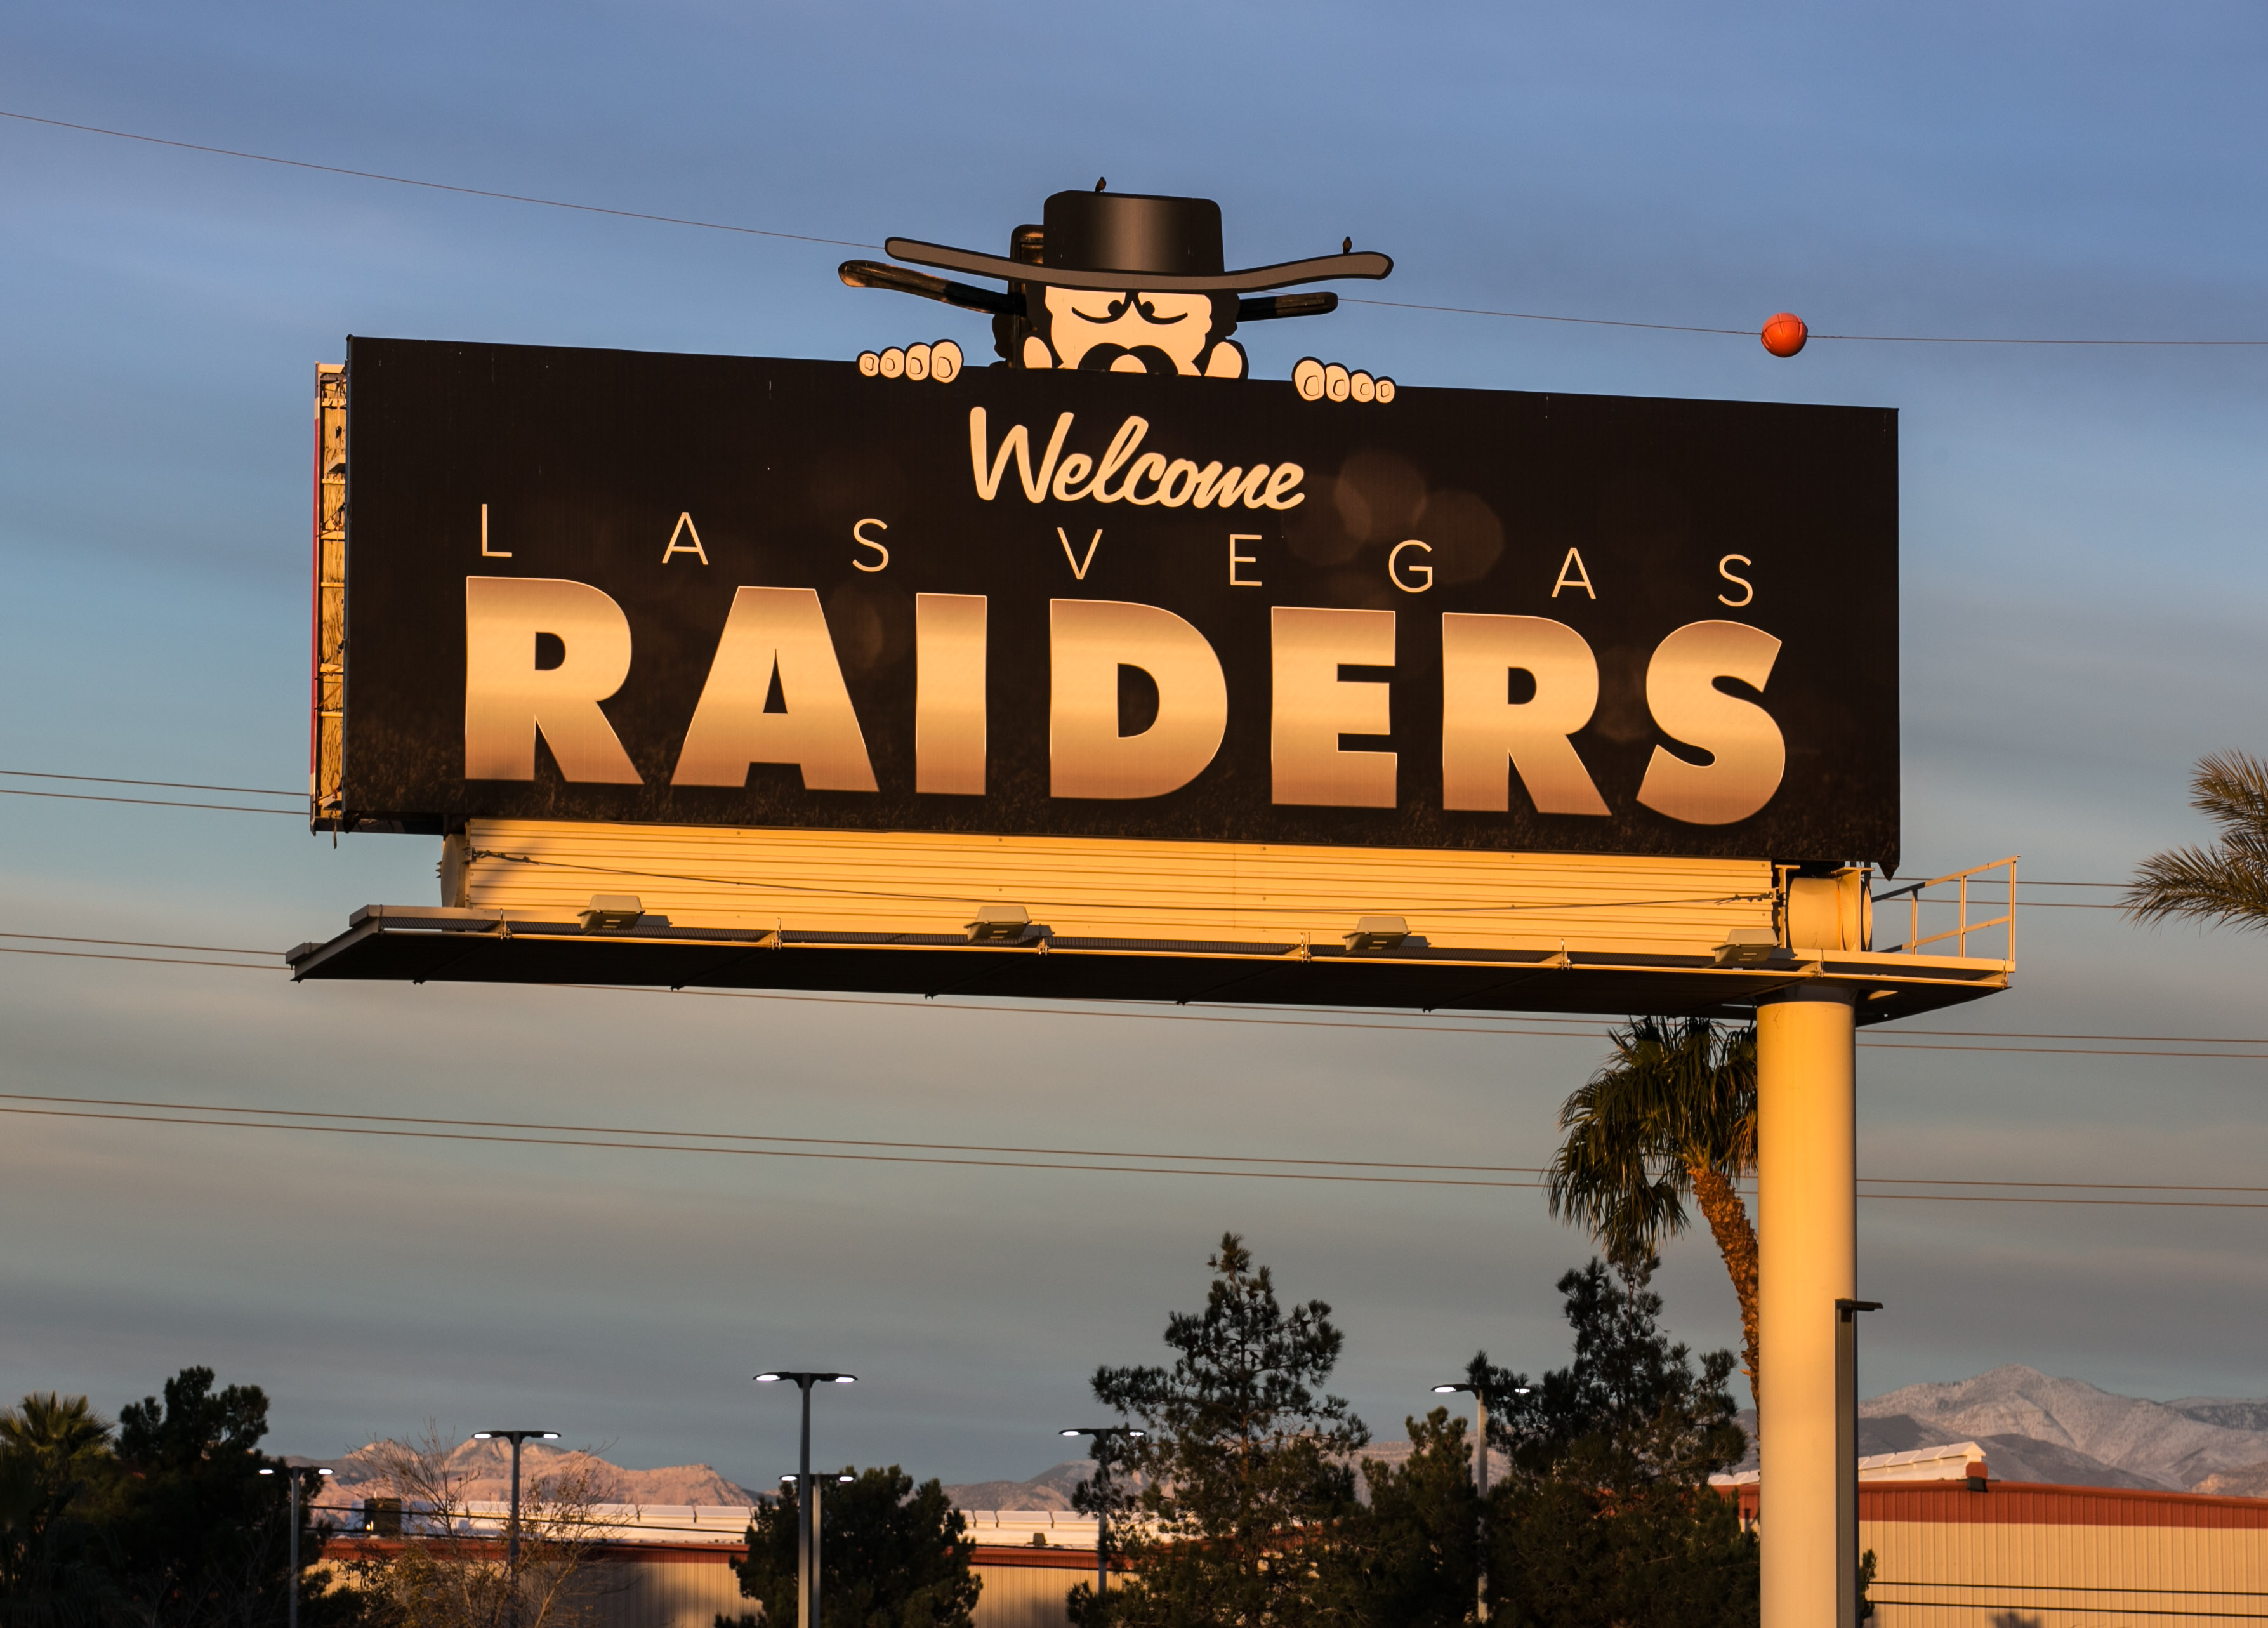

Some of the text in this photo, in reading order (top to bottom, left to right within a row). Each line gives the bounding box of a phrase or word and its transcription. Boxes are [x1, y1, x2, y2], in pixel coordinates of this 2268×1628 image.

[969, 406, 1306, 511] Welcome
[480, 503, 1755, 607] LAS VEGAS
[464, 575, 1786, 824] RAIDERS
